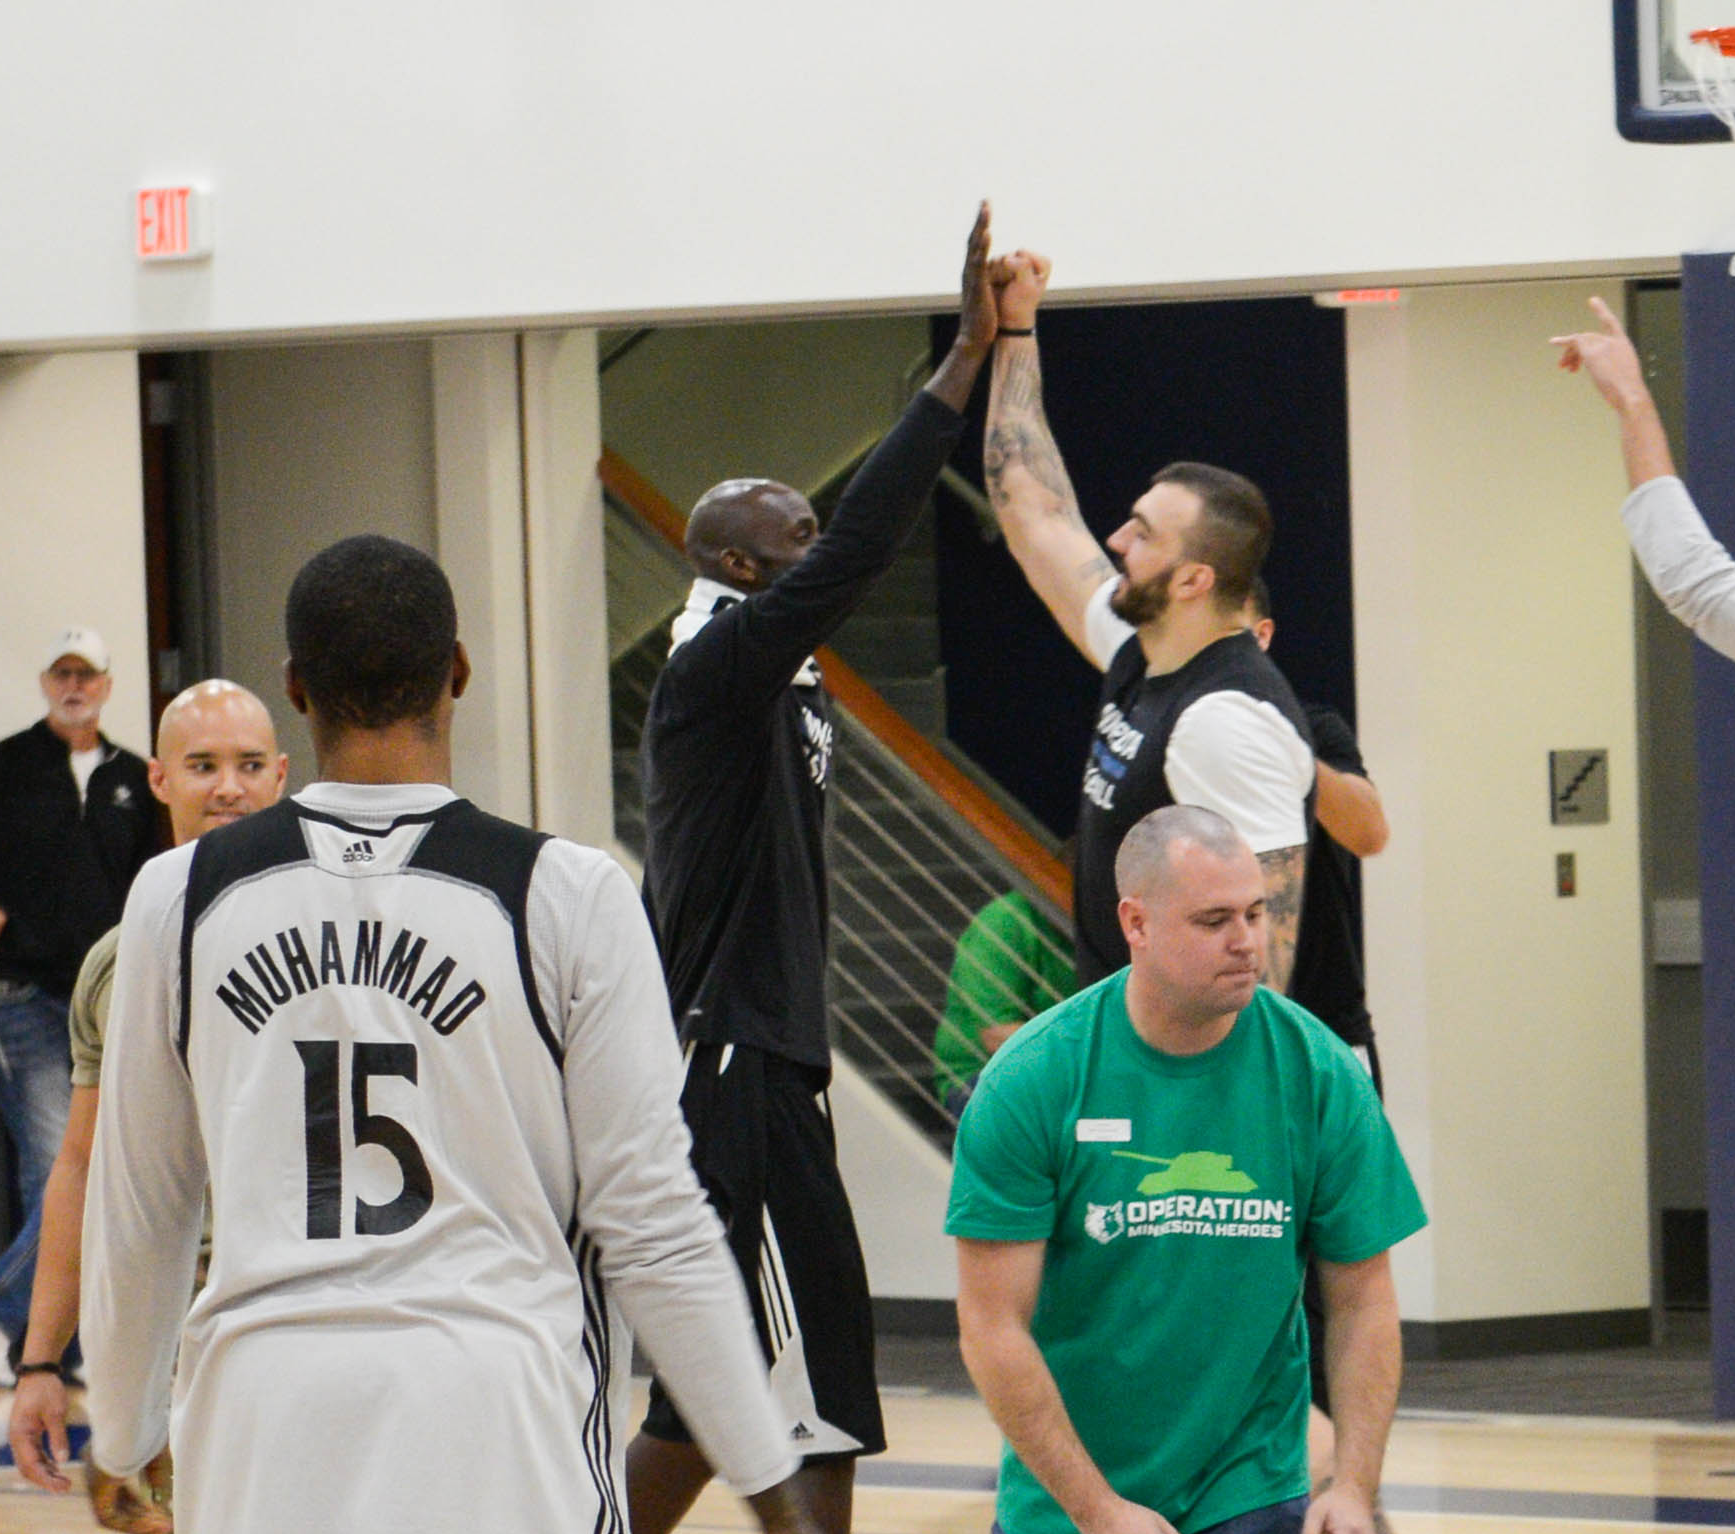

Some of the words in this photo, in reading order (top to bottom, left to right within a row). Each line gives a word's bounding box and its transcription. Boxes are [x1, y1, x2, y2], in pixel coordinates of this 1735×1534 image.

[136, 187, 191, 256] EXIT
[216, 920, 486, 1036] MUHAMMAD
[293, 1040, 434, 1240] 15
[1127, 1195, 1293, 1223] OPERATION:
[1127, 1219, 1213, 1238] MINNESOTA
[1215, 1223, 1283, 1239] HEROES
